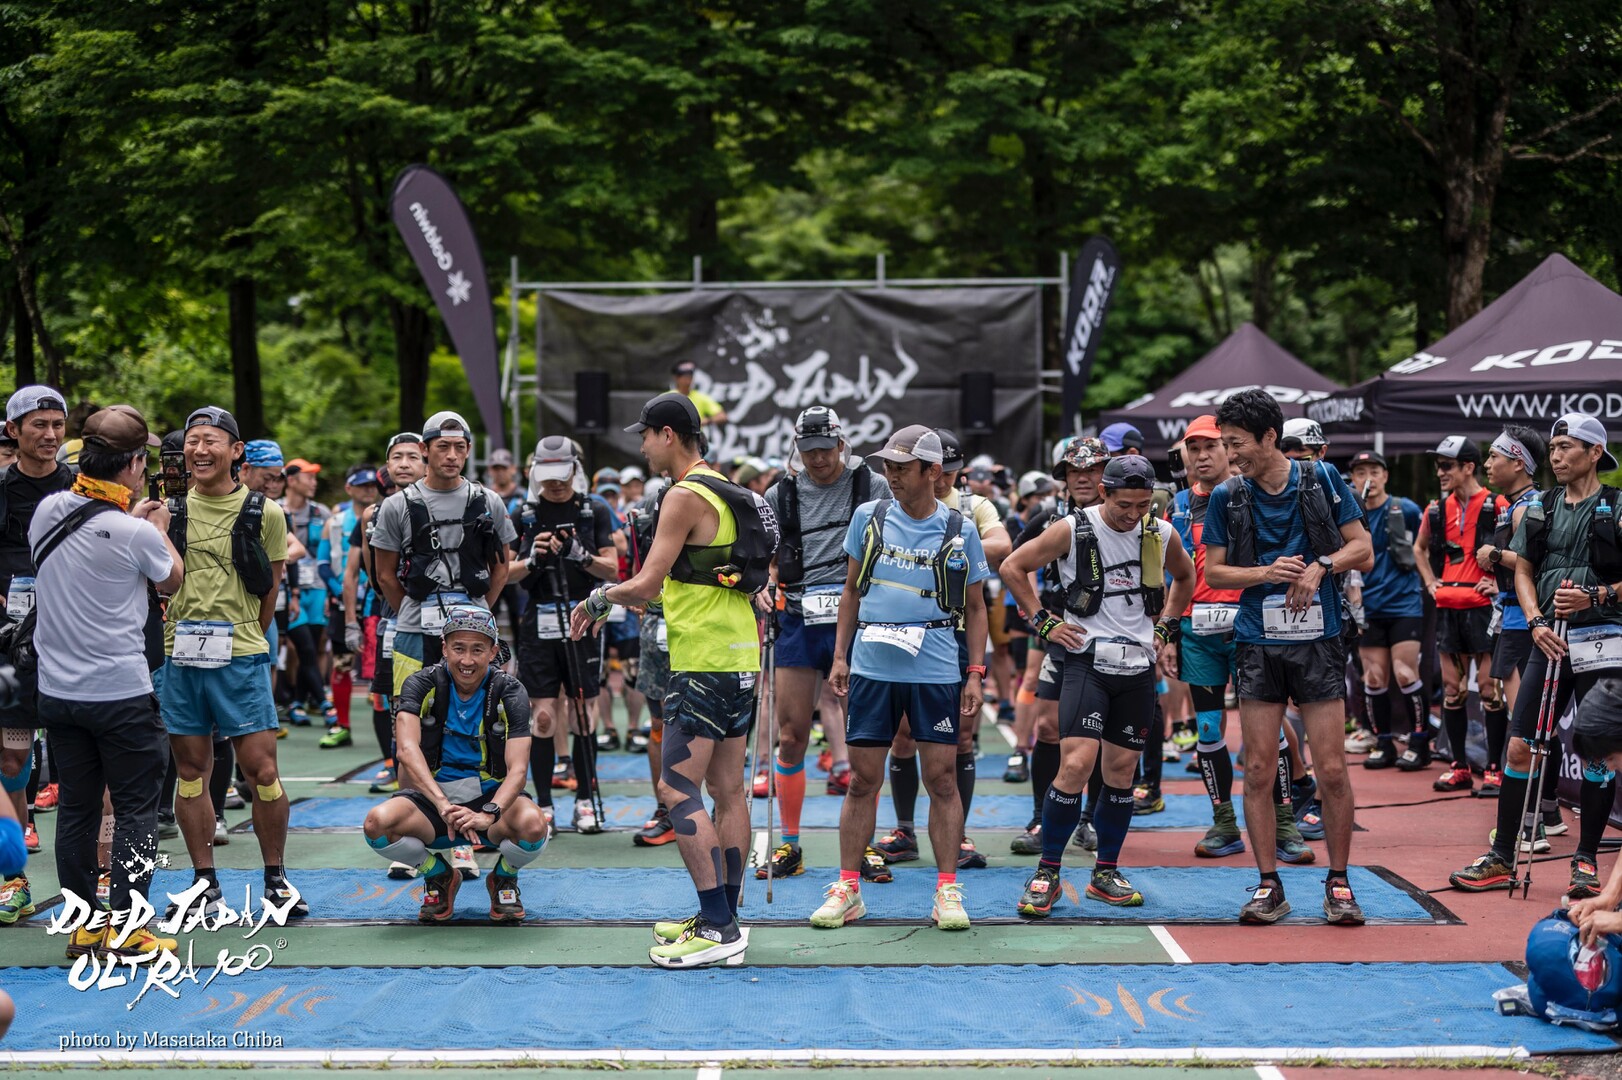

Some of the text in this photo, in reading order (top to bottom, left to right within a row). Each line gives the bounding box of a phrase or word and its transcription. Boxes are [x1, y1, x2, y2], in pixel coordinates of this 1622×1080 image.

[773, 328, 919, 412] JAPAN
[817, 596, 840, 609] 120
[1207, 609, 1229, 623] 177
[1281, 608, 1308, 624] 172
[198, 636, 207, 651] 7
[1594, 641, 1603, 654] 9
[1121, 645, 1126, 660] 1
